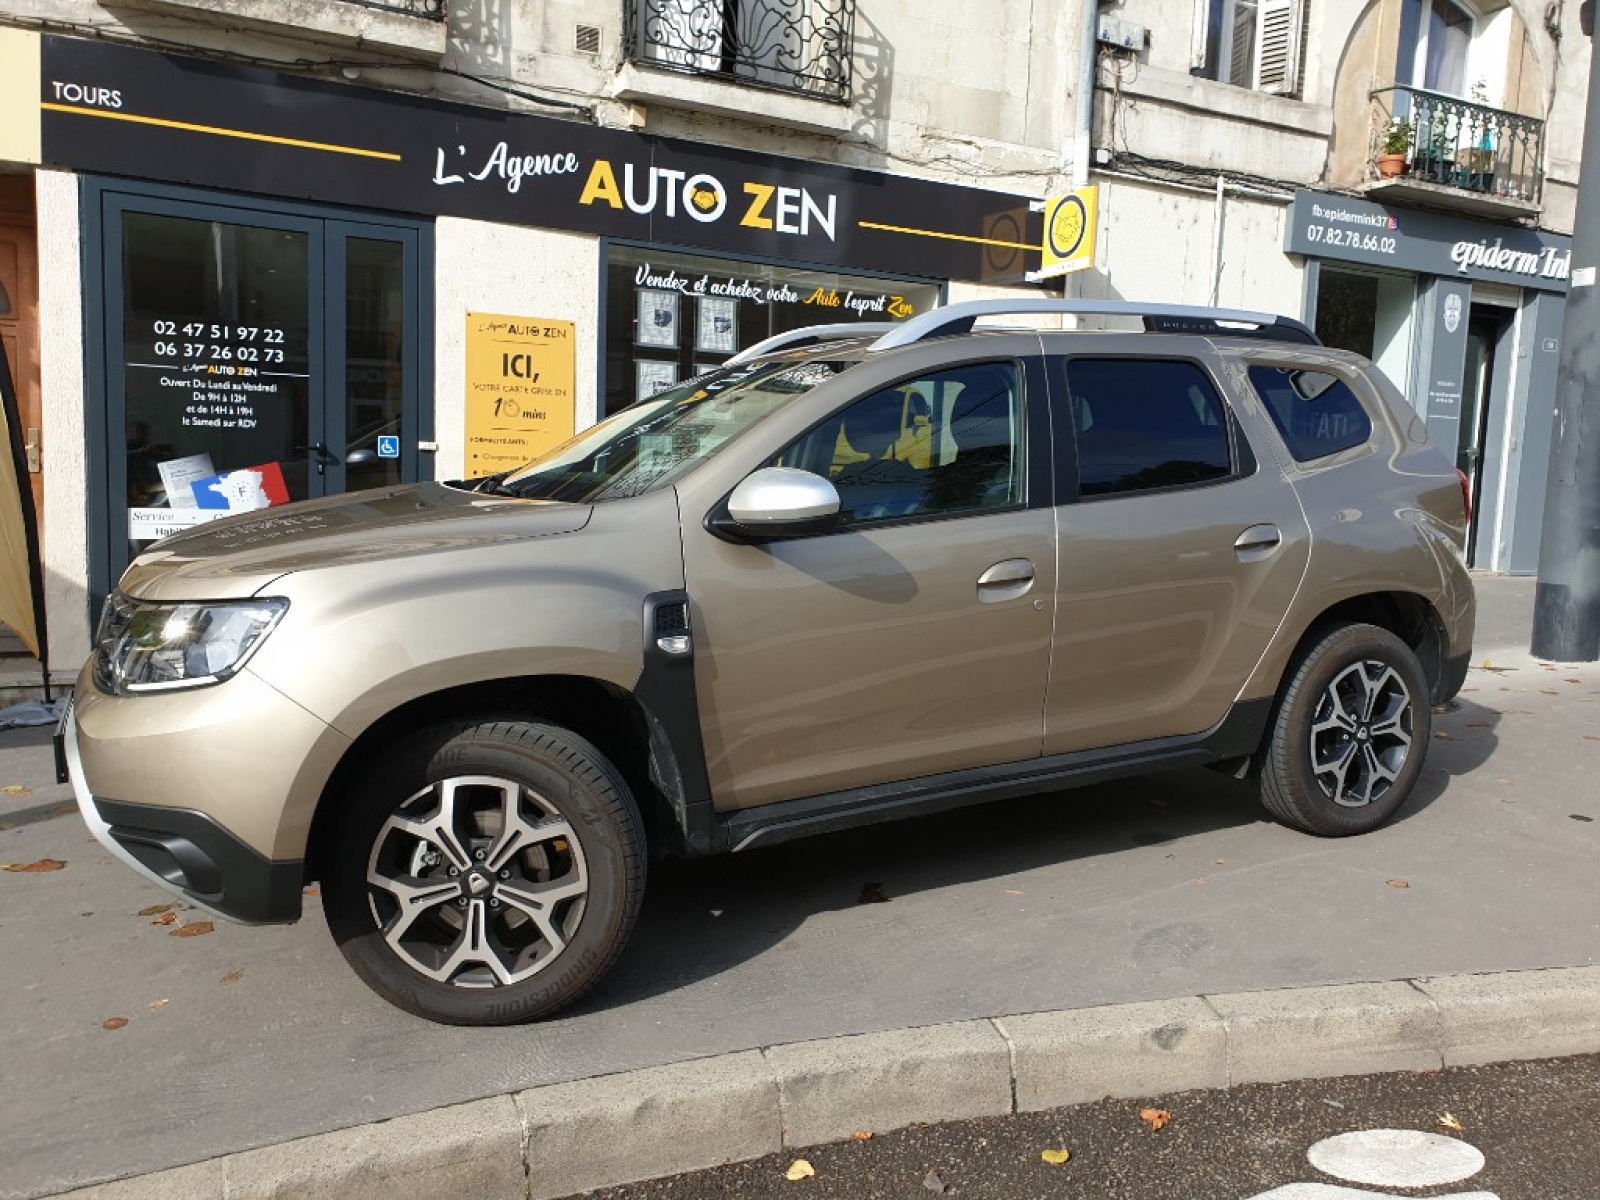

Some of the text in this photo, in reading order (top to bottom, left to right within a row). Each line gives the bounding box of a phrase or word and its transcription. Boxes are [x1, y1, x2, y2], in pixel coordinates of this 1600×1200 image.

[52, 81, 123, 109] TOURS
[578, 160, 727, 223] AUTO
[740, 182, 837, 242] ZEN
[1307, 224, 1397, 254] 07.82.78.66.02
[635, 262, 705, 296] Vendez
[694, 274, 707, 292] et
[711, 277, 765, 303] achetez
[766, 287, 798, 304] votre
[803, 287, 841, 308] Auto
[887, 296, 914, 318] Zen
[154, 320, 285, 343] 02 47 51 97 22
[508, 324, 540, 337] AUTO
[543, 327, 567, 339] ZEN
[154, 342, 285, 363] 06 37 26 02 73
[208, 364, 236, 376] AUTO
[237, 366, 258, 377] ZEN
[502, 352, 540, 384] ICI,
[160, 376, 191, 388] Ouvert
[193, 379, 206, 389] Du
[208, 380, 231, 391] Lundi
[242, 382, 278, 393] Vendredi
[473, 382, 567, 396] VOTRE CARTE GRISE EN
[193, 391, 206, 401] De
[230, 394, 247, 403] 12H
[186, 405, 196, 414] et
[197, 405, 208, 414] de
[210, 406, 227, 415] 14H
[522, 408, 546, 420] mins
[182, 417, 257, 428] le Samedi sur RDV
[133, 512, 174, 521] Service
